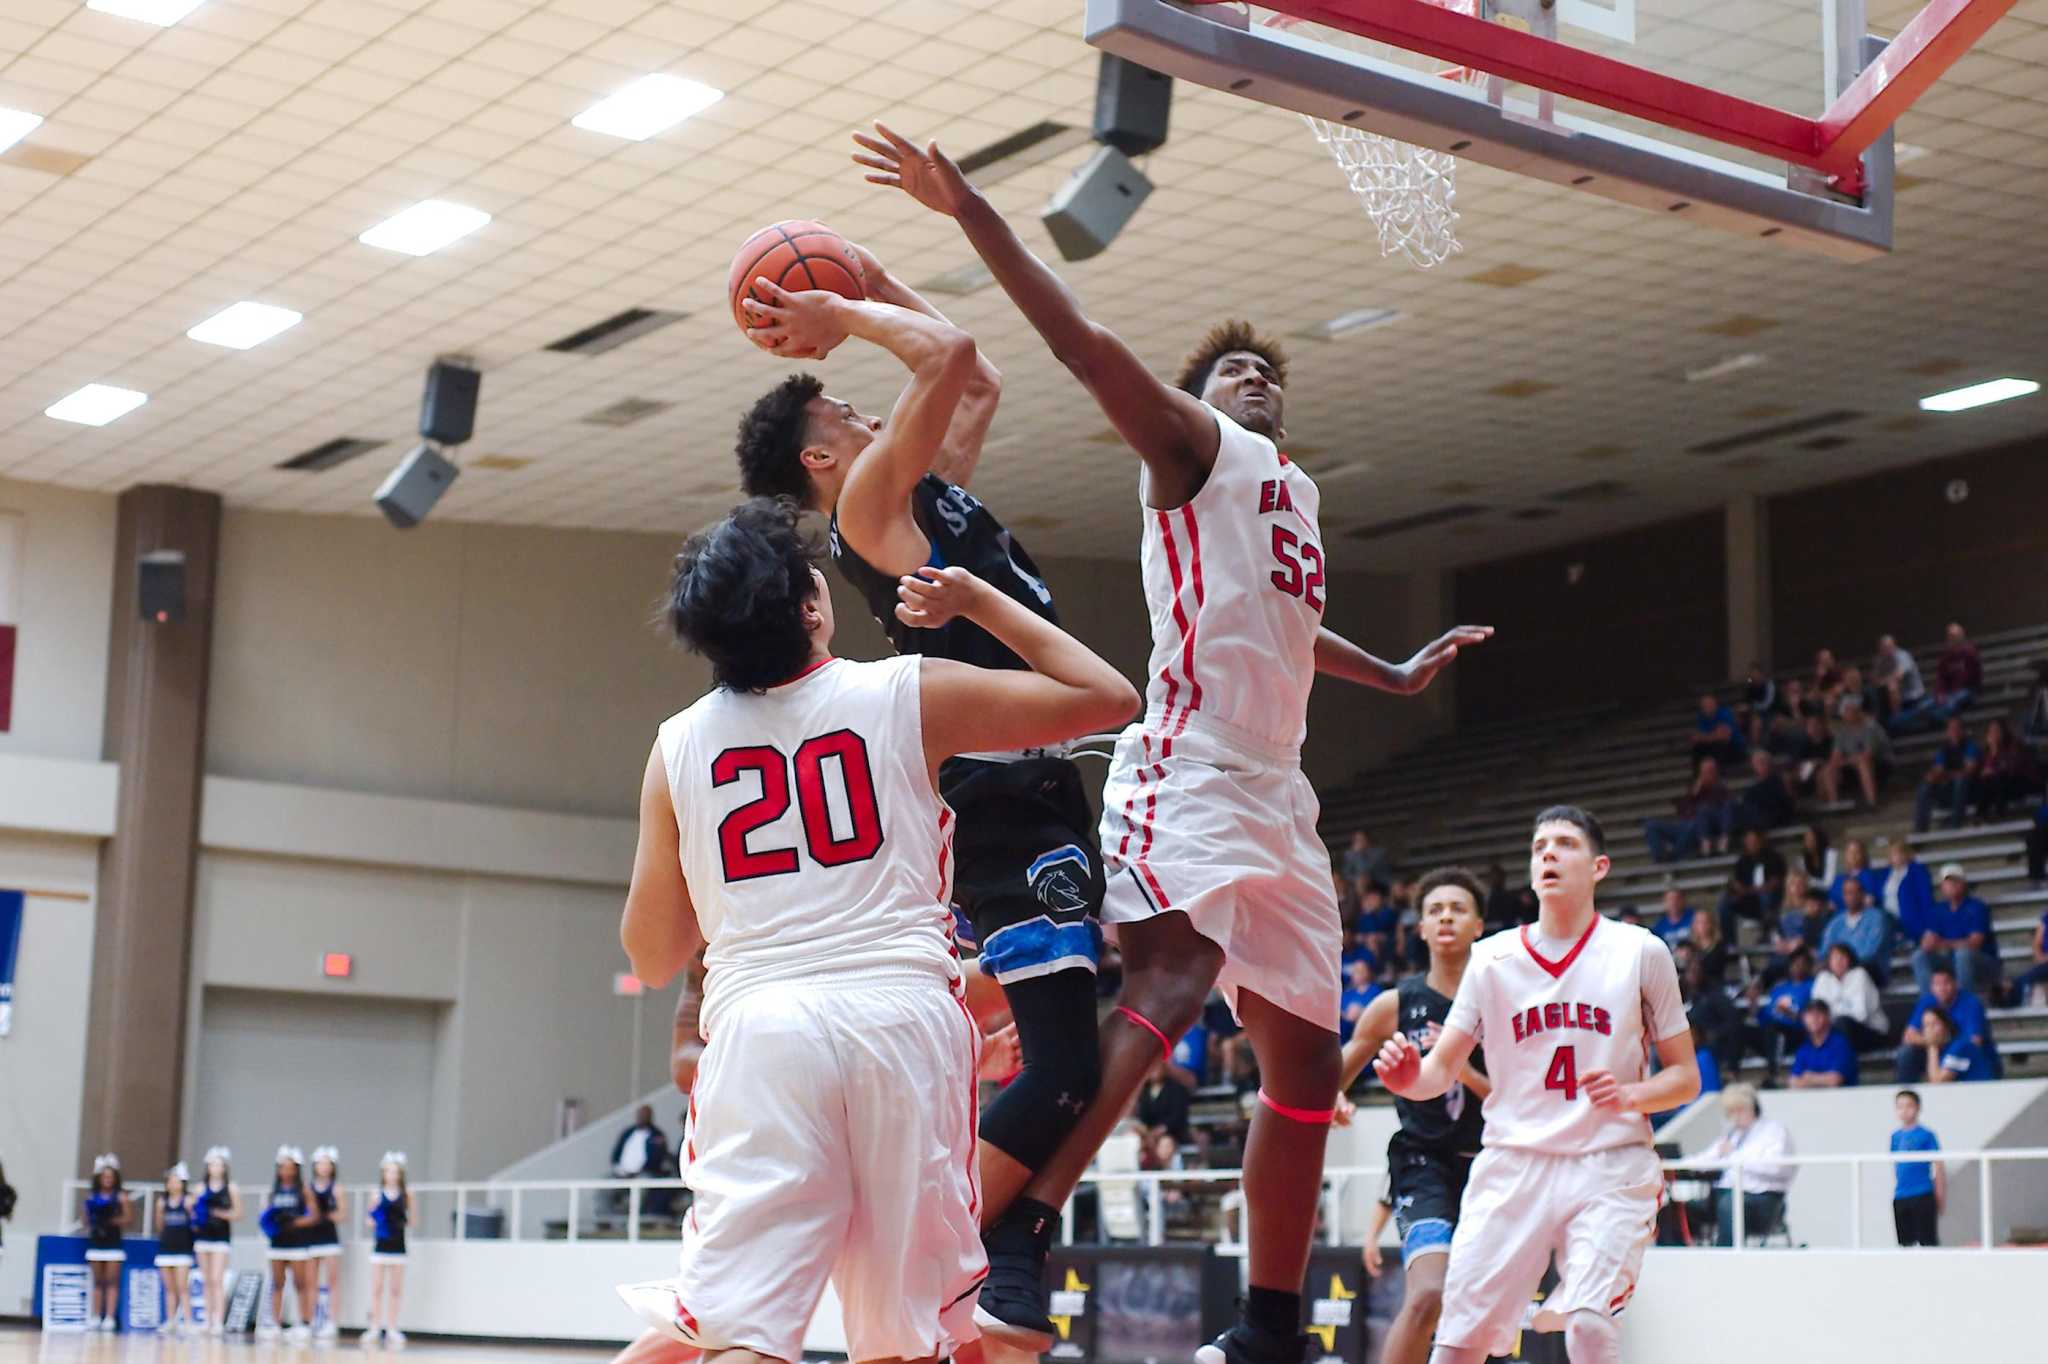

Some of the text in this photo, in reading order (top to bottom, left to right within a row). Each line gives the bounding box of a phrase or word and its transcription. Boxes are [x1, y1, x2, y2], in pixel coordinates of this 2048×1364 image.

[1271, 524, 1326, 614] 52
[711, 728, 885, 882] 20
[1511, 1001, 1613, 1044] EAGLES
[1544, 1045, 1579, 1101] 4
